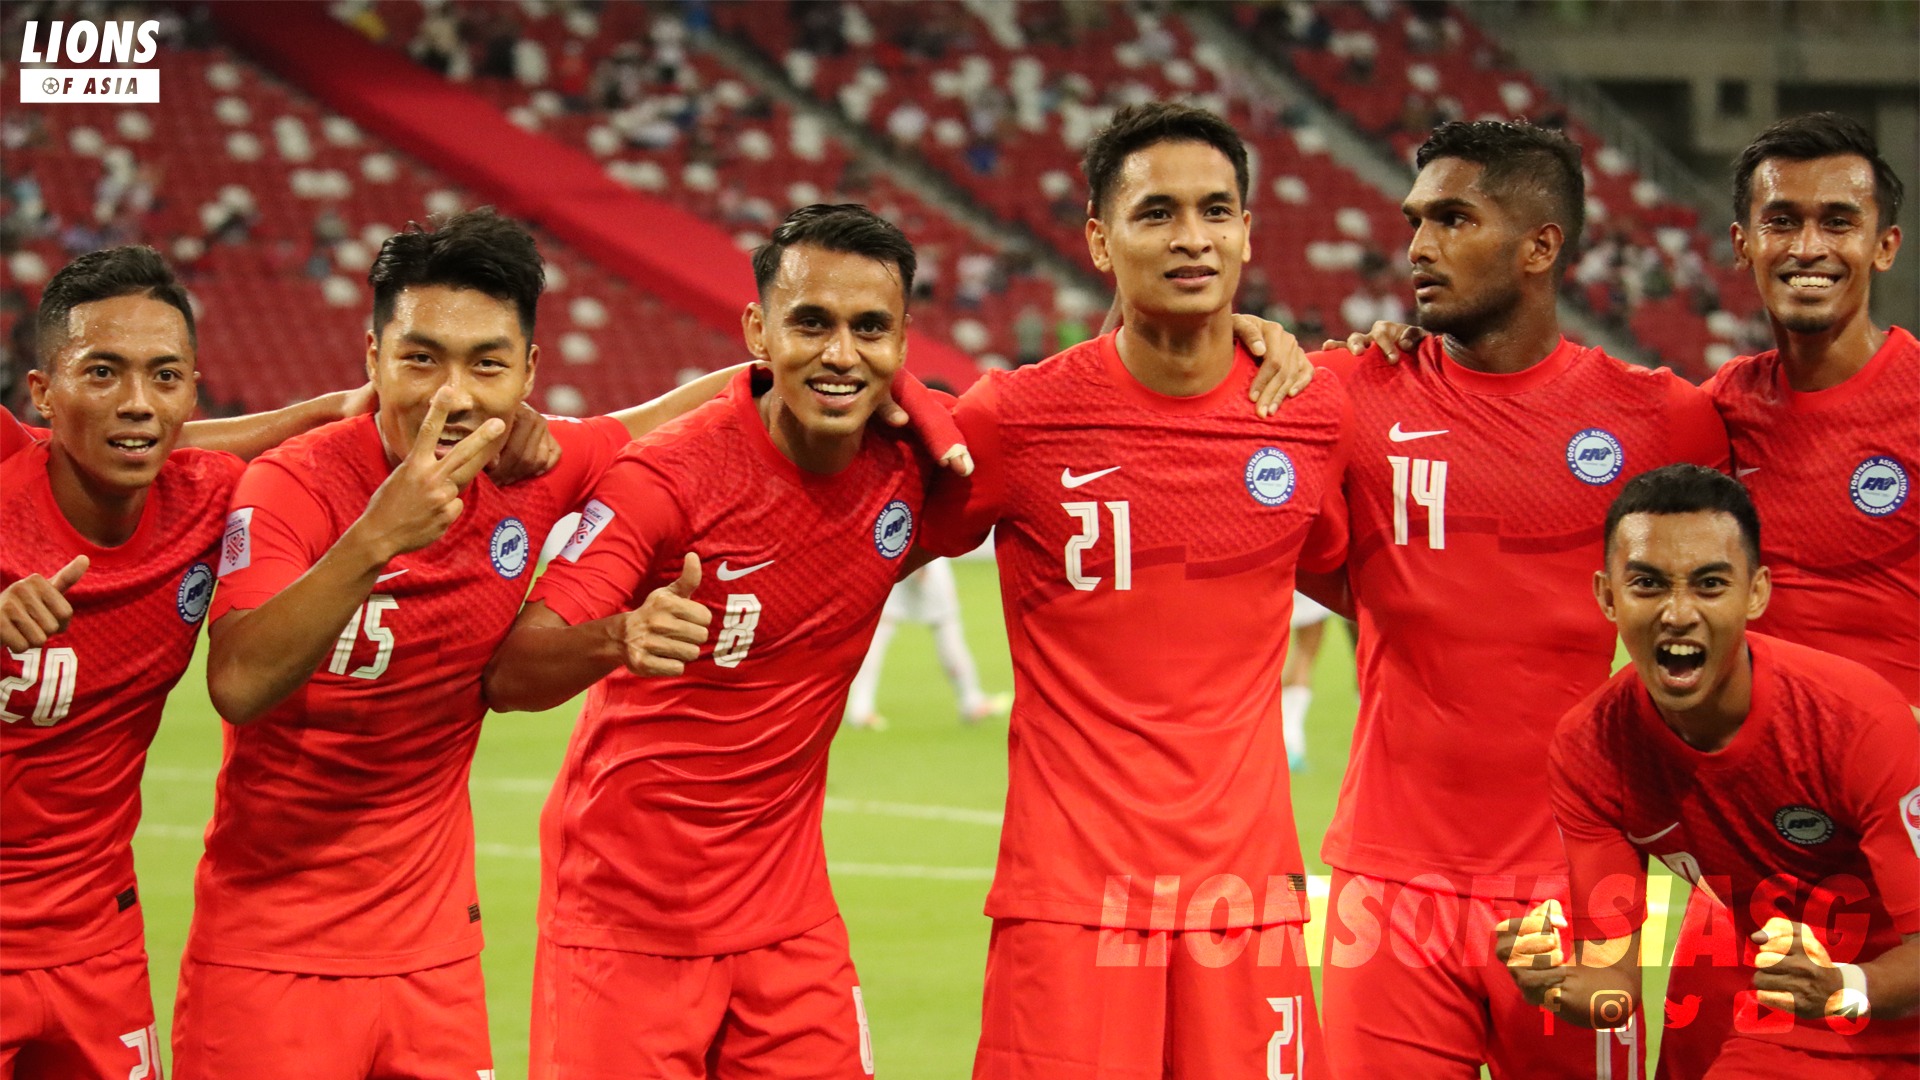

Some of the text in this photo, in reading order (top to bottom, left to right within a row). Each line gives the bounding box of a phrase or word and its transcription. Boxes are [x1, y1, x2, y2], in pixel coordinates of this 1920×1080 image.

[1246, 449, 1295, 486] FOOTBALL ASSOCIATION
[1567, 430, 1622, 467] FOOTBALL ASSOCIATION
[1574, 469, 1615, 483] SINGAPORE
[1850, 459, 1907, 498] FOOTBALL ASSOCIATION
[1251, 490, 1289, 504] SINGAPORE
[1386, 455, 1448, 550] 14
[1854, 498, 1896, 514] SINGAPORE
[1060, 501, 1131, 591] 21
[328, 594, 400, 680] 15
[712, 593, 762, 668] 8
[0, 646, 78, 727] 20
